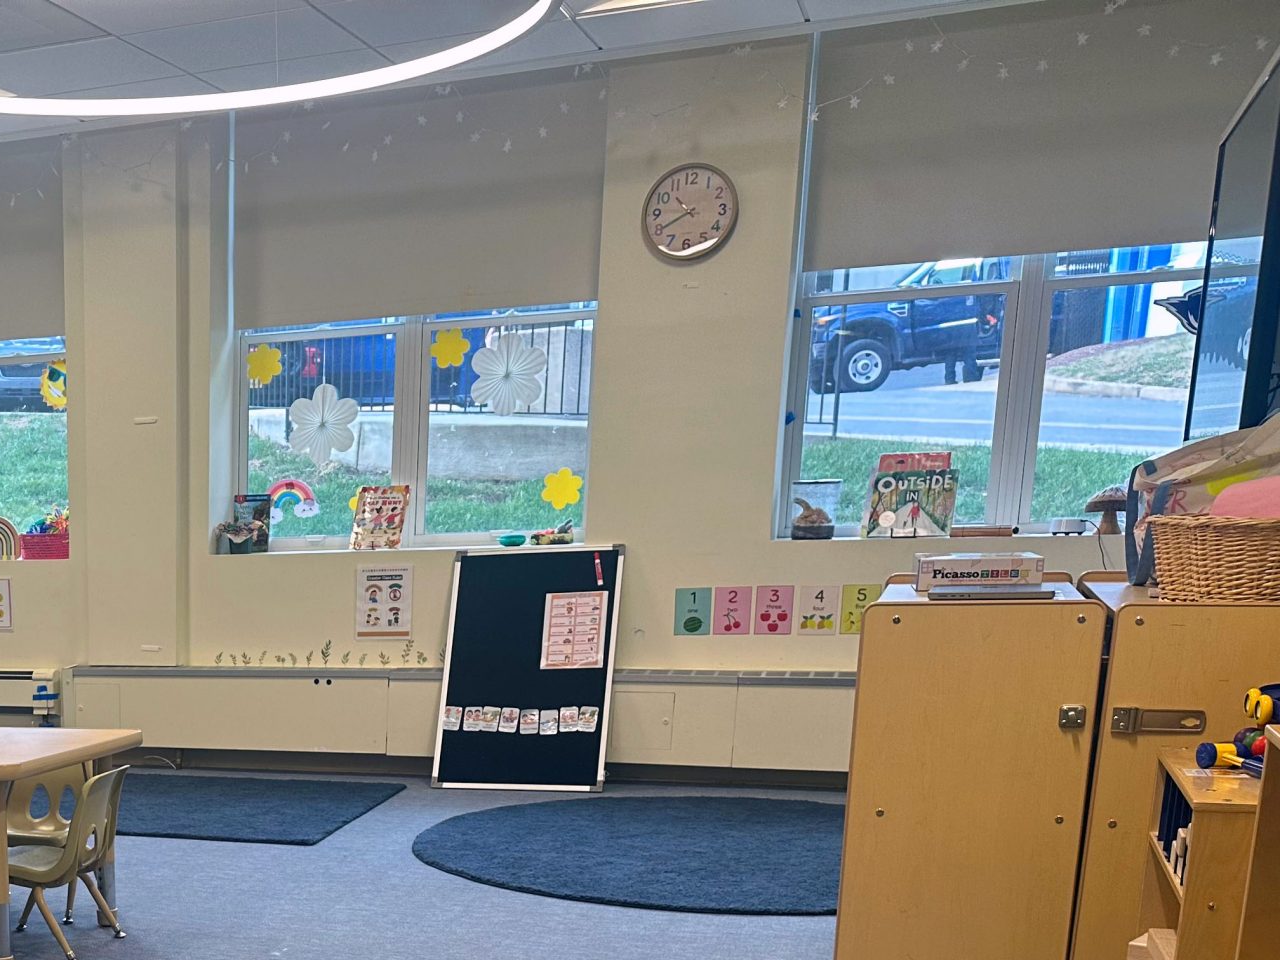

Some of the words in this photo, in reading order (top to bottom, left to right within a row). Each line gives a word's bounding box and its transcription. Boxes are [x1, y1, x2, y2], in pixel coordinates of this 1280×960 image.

[685, 172, 698, 185] 12
[706, 176, 711, 189] 1
[671, 179, 680, 192] 11
[657, 192, 670, 205] 10
[715, 186, 723, 199] 2
[652, 208, 661, 221] 9
[718, 203, 727, 216] 3
[654, 224, 663, 236] 8
[711, 219, 721, 232] 4
[666, 234, 676, 247] 7
[682, 238, 691, 250] 6
[699, 232, 708, 244] 5
[690, 591, 697, 605] 1
[728, 590, 738, 604] 2
[769, 589, 780, 602] 3
[814, 590, 824, 603] 4
[856, 588, 867, 602] 5
